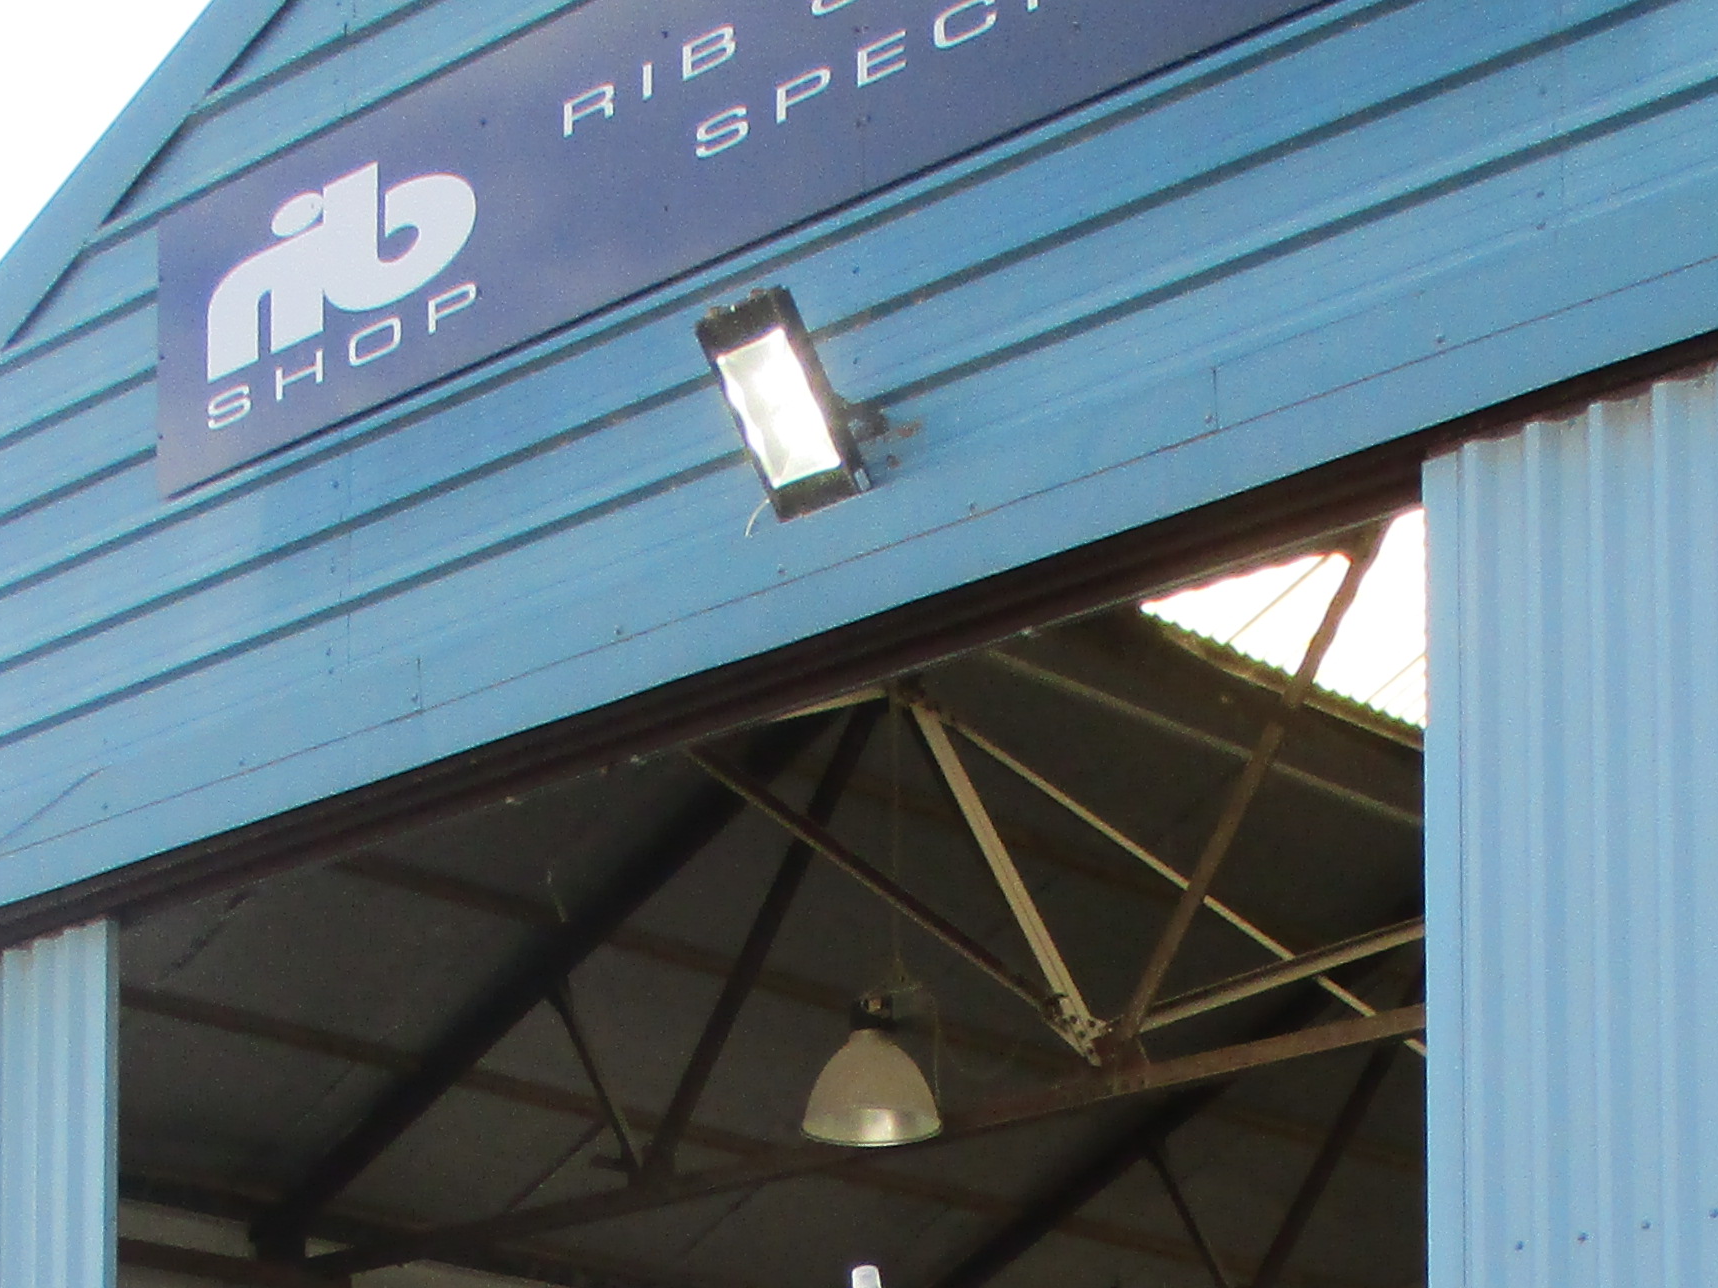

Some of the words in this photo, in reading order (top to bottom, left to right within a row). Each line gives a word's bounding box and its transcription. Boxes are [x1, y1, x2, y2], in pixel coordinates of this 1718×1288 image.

[563, 22, 737, 138] RIB
[695, 0, 1039, 159] SPEC
[208, 281, 476, 429] SHOP
